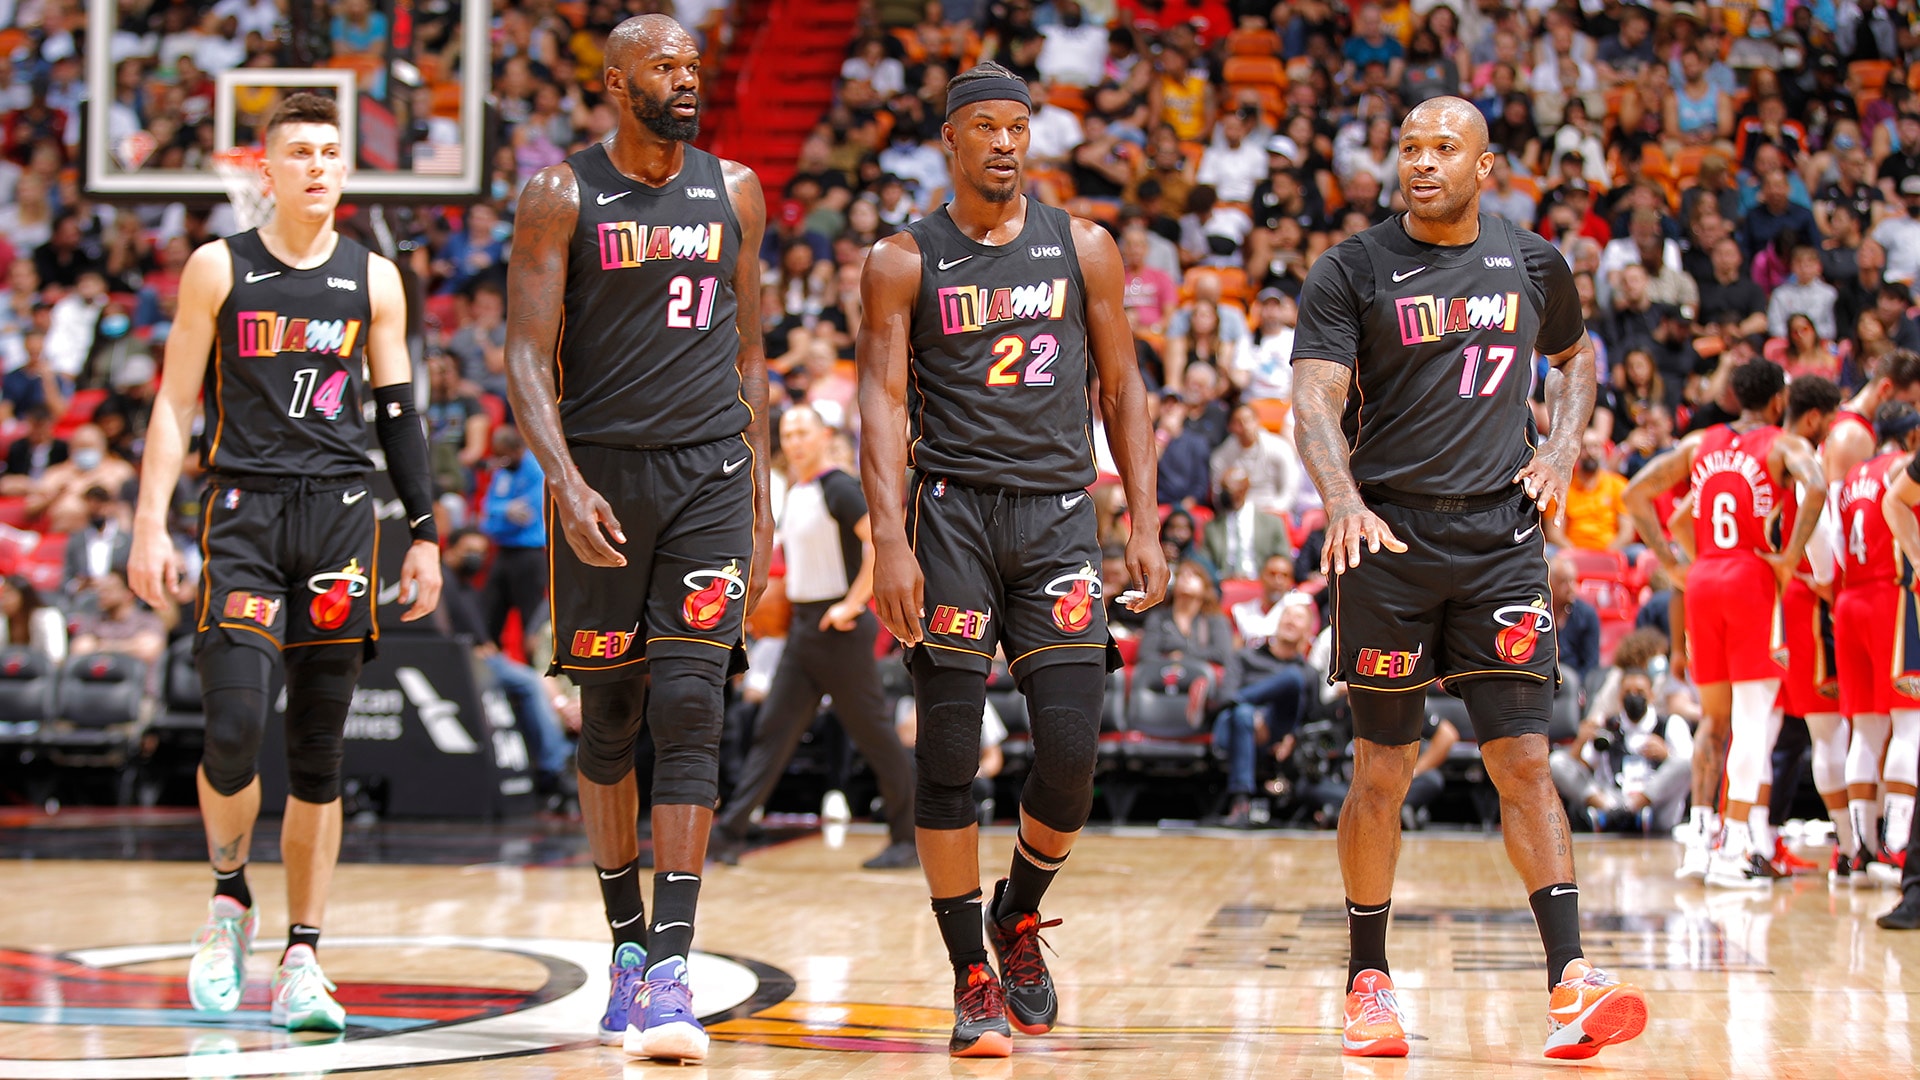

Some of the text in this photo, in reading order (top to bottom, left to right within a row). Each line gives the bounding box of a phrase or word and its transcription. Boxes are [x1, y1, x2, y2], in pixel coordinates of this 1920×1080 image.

[687, 187, 716, 199] UKG
[597, 221, 724, 271] MIAMI
[1031, 246, 1062, 258] UKG
[1484, 256, 1513, 268] UKG
[666, 275, 719, 330] 21
[937, 278, 1068, 335] MIAMI
[1395, 291, 1520, 346] MIAMI
[237, 310, 362, 359] MIAMI
[986, 333, 1060, 387] 22
[287, 368, 350, 421] 14
[1458, 345, 1517, 398] 17
[1711, 491, 1739, 549] 6
[1848, 508, 1867, 565] 4
